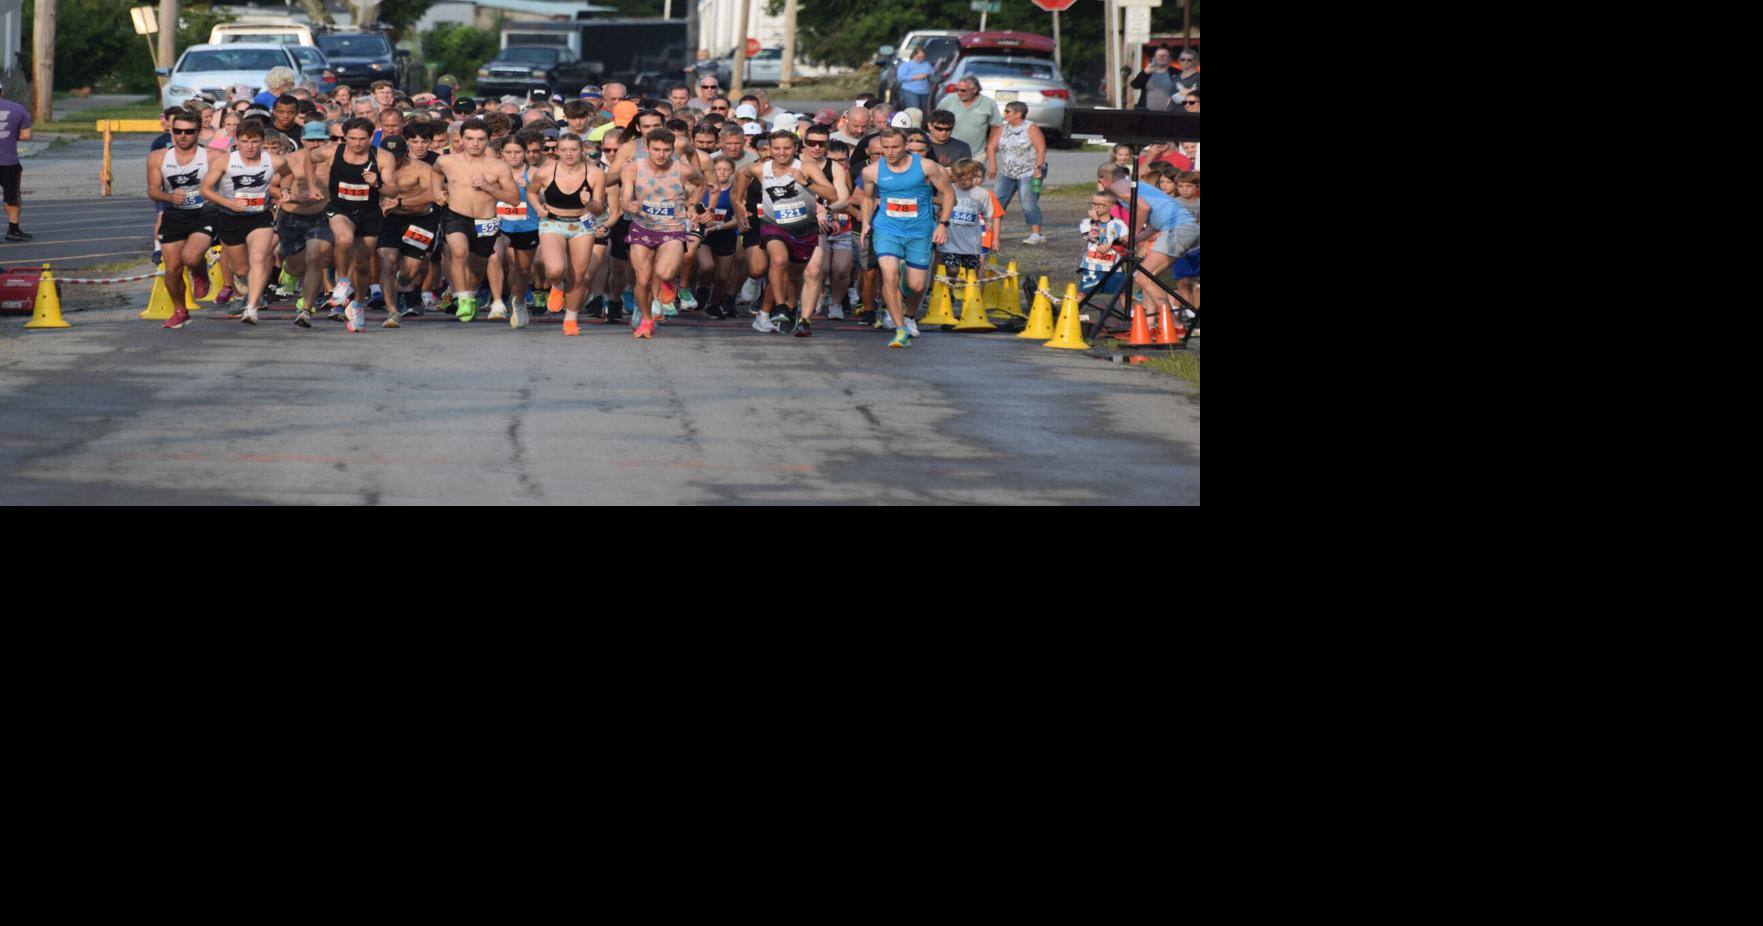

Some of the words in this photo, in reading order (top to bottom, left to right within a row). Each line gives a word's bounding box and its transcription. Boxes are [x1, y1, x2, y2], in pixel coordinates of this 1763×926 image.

[646, 207, 669, 215] 474
[894, 204, 909, 212] 78
[780, 209, 802, 218] 521
[953, 213, 973, 221] 546
